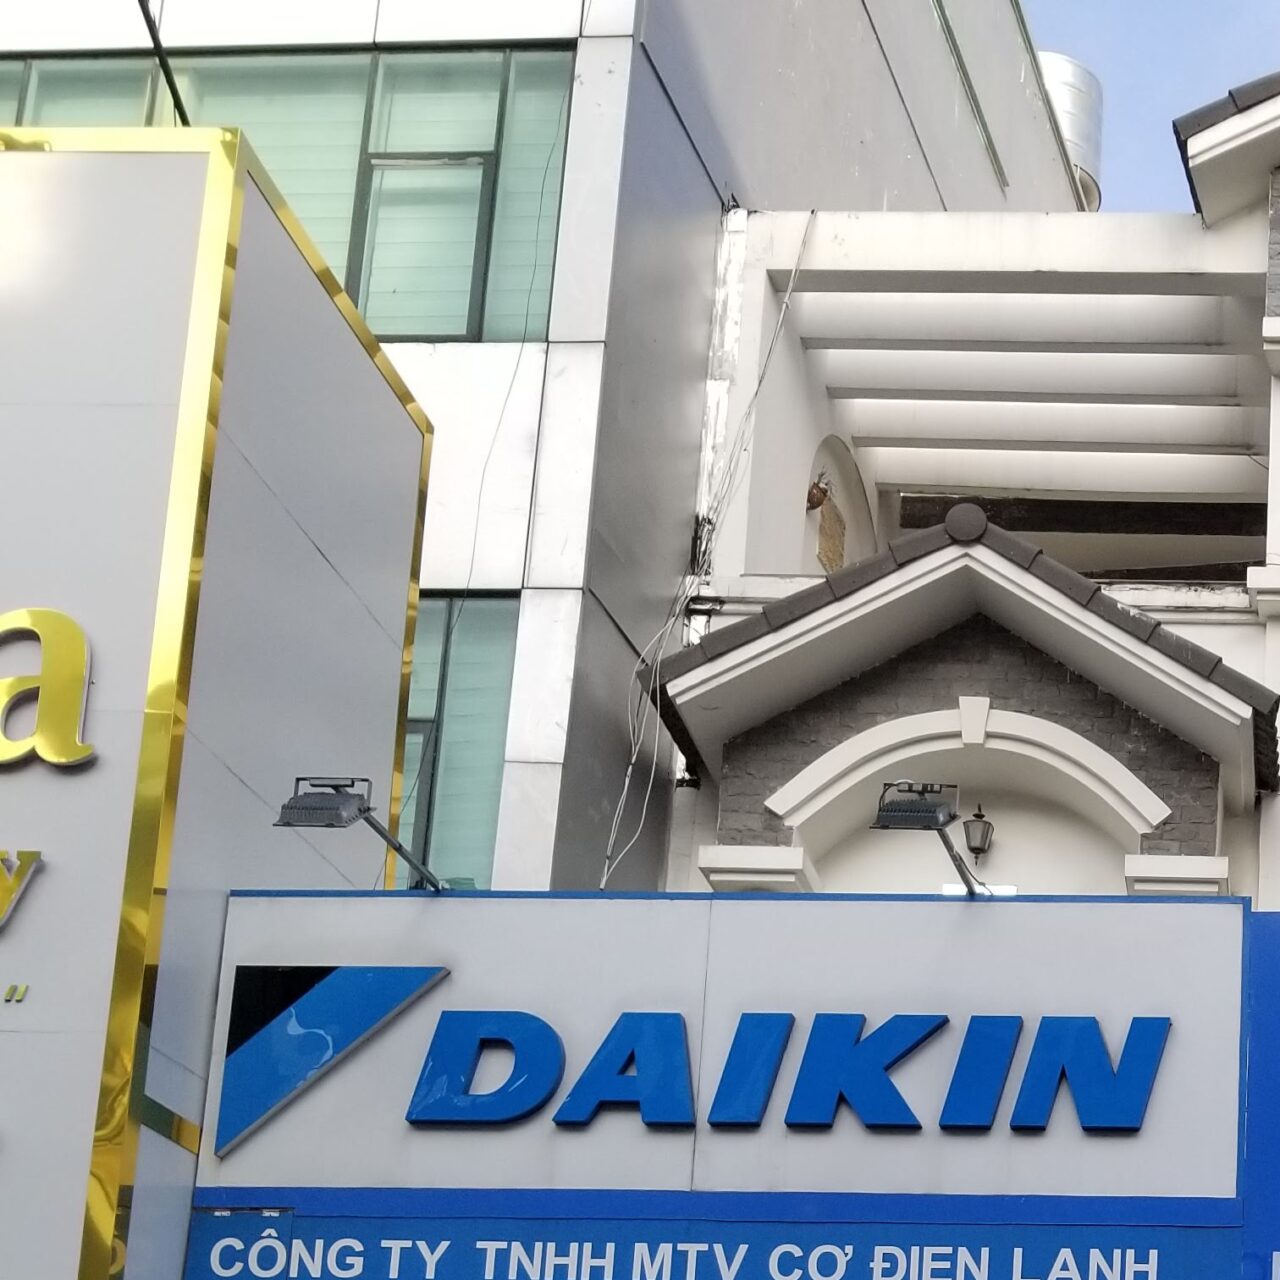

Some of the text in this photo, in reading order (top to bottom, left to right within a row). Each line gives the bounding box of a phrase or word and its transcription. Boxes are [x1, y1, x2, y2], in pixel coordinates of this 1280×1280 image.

[405, 1010, 1172, 1132] DAIKIN
[209, 1228, 365, 1279] CÔNG
[380, 1239, 451, 1280] TY
